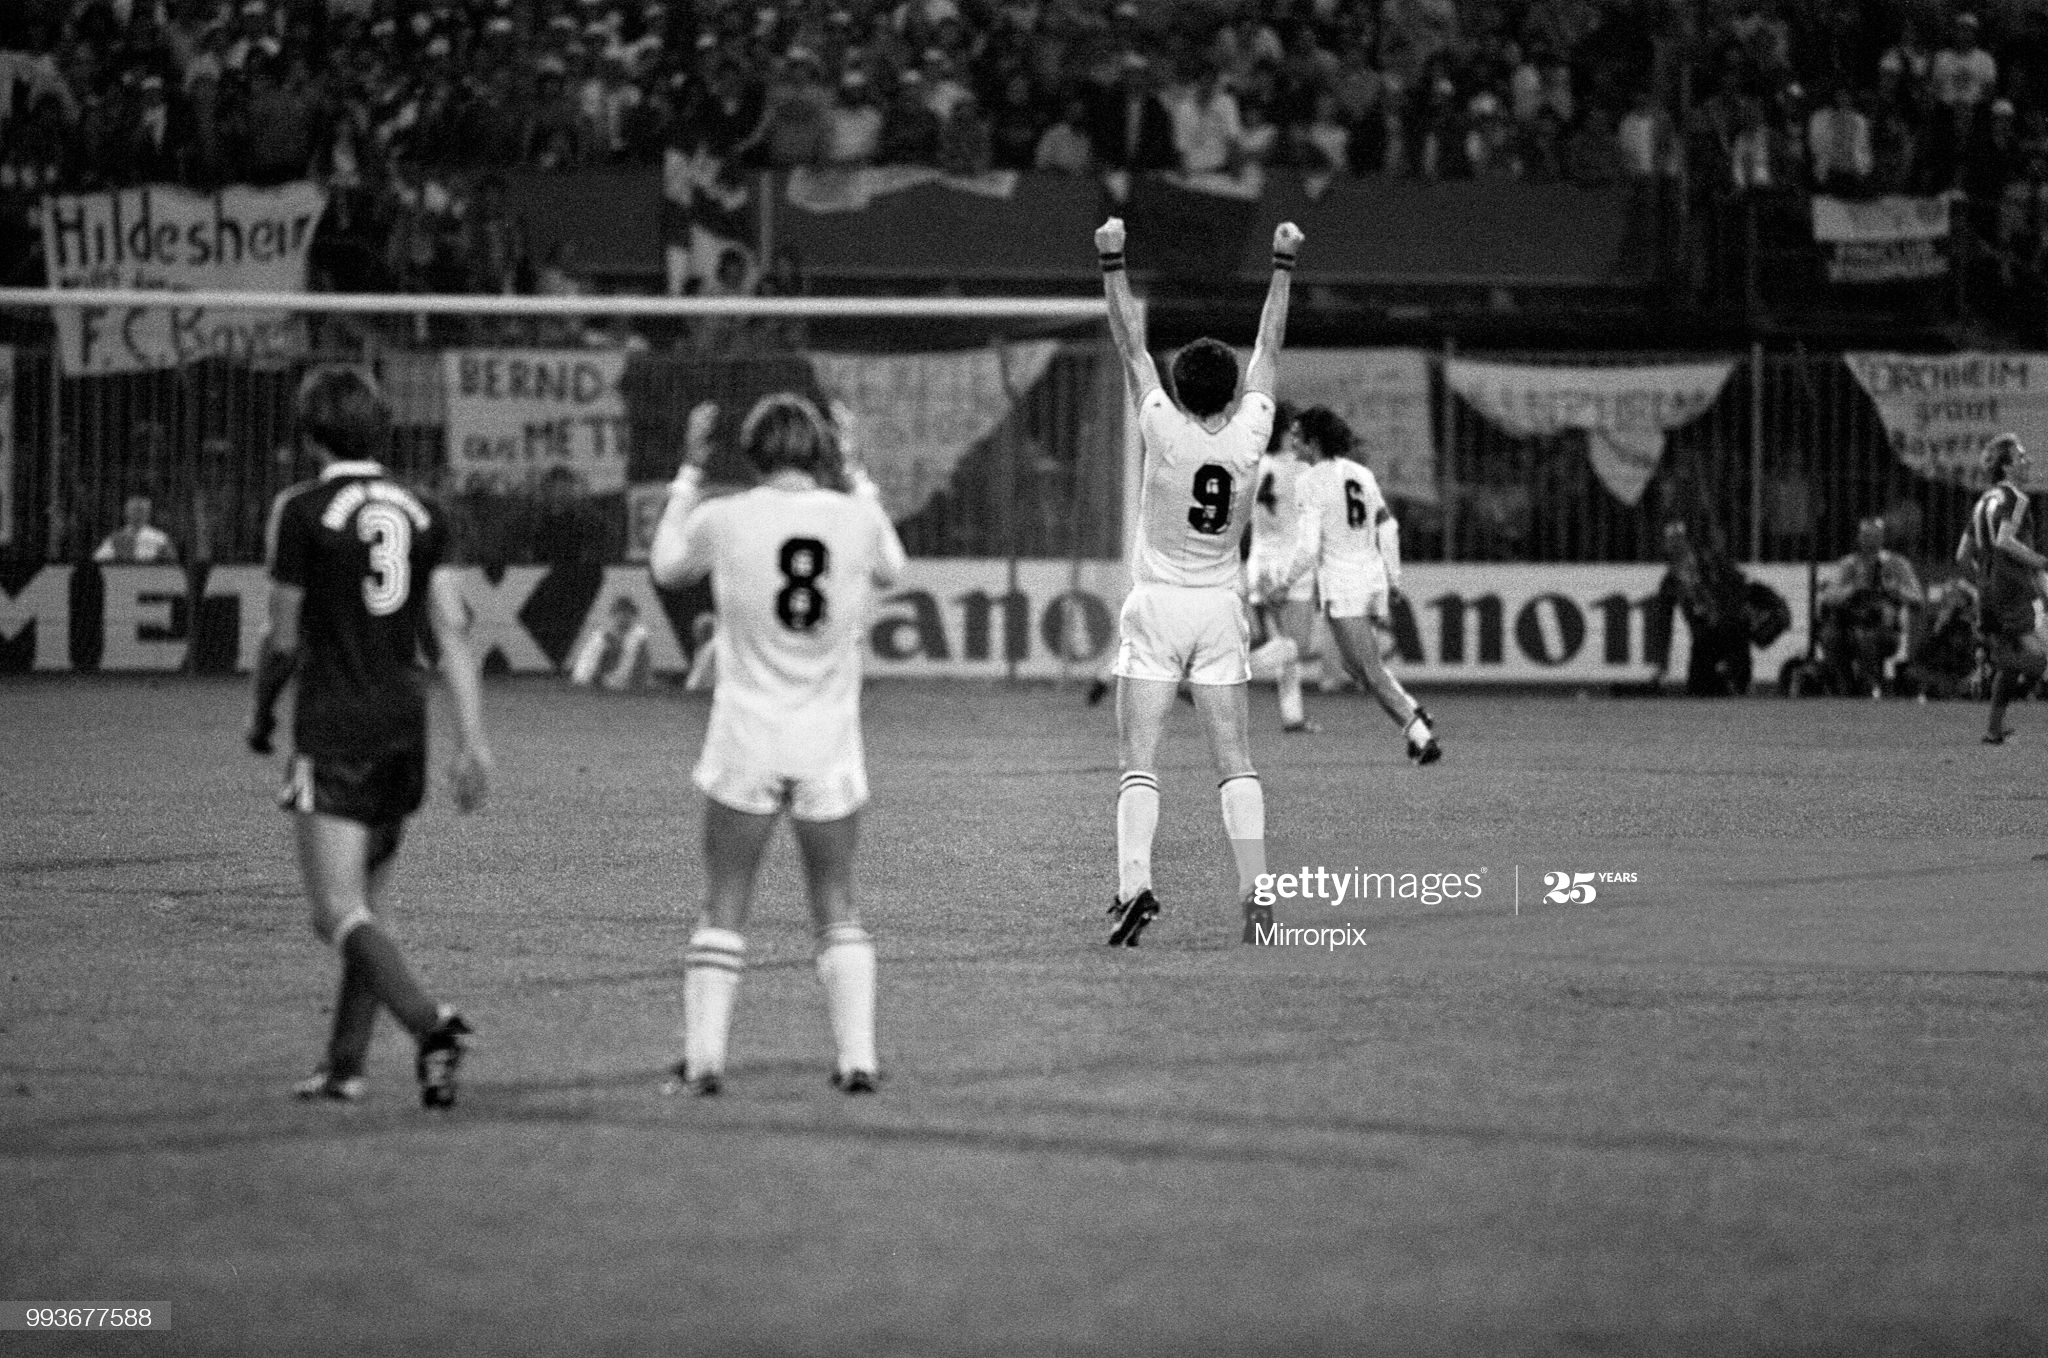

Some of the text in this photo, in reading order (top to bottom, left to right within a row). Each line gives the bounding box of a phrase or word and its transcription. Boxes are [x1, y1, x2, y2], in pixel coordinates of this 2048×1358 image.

[1187, 463, 1233, 535] 9
[1344, 478, 1367, 529] 6
[357, 502, 411, 616] 3
[775, 537, 828, 633] 8
[0, 565, 689, 670] METXA
